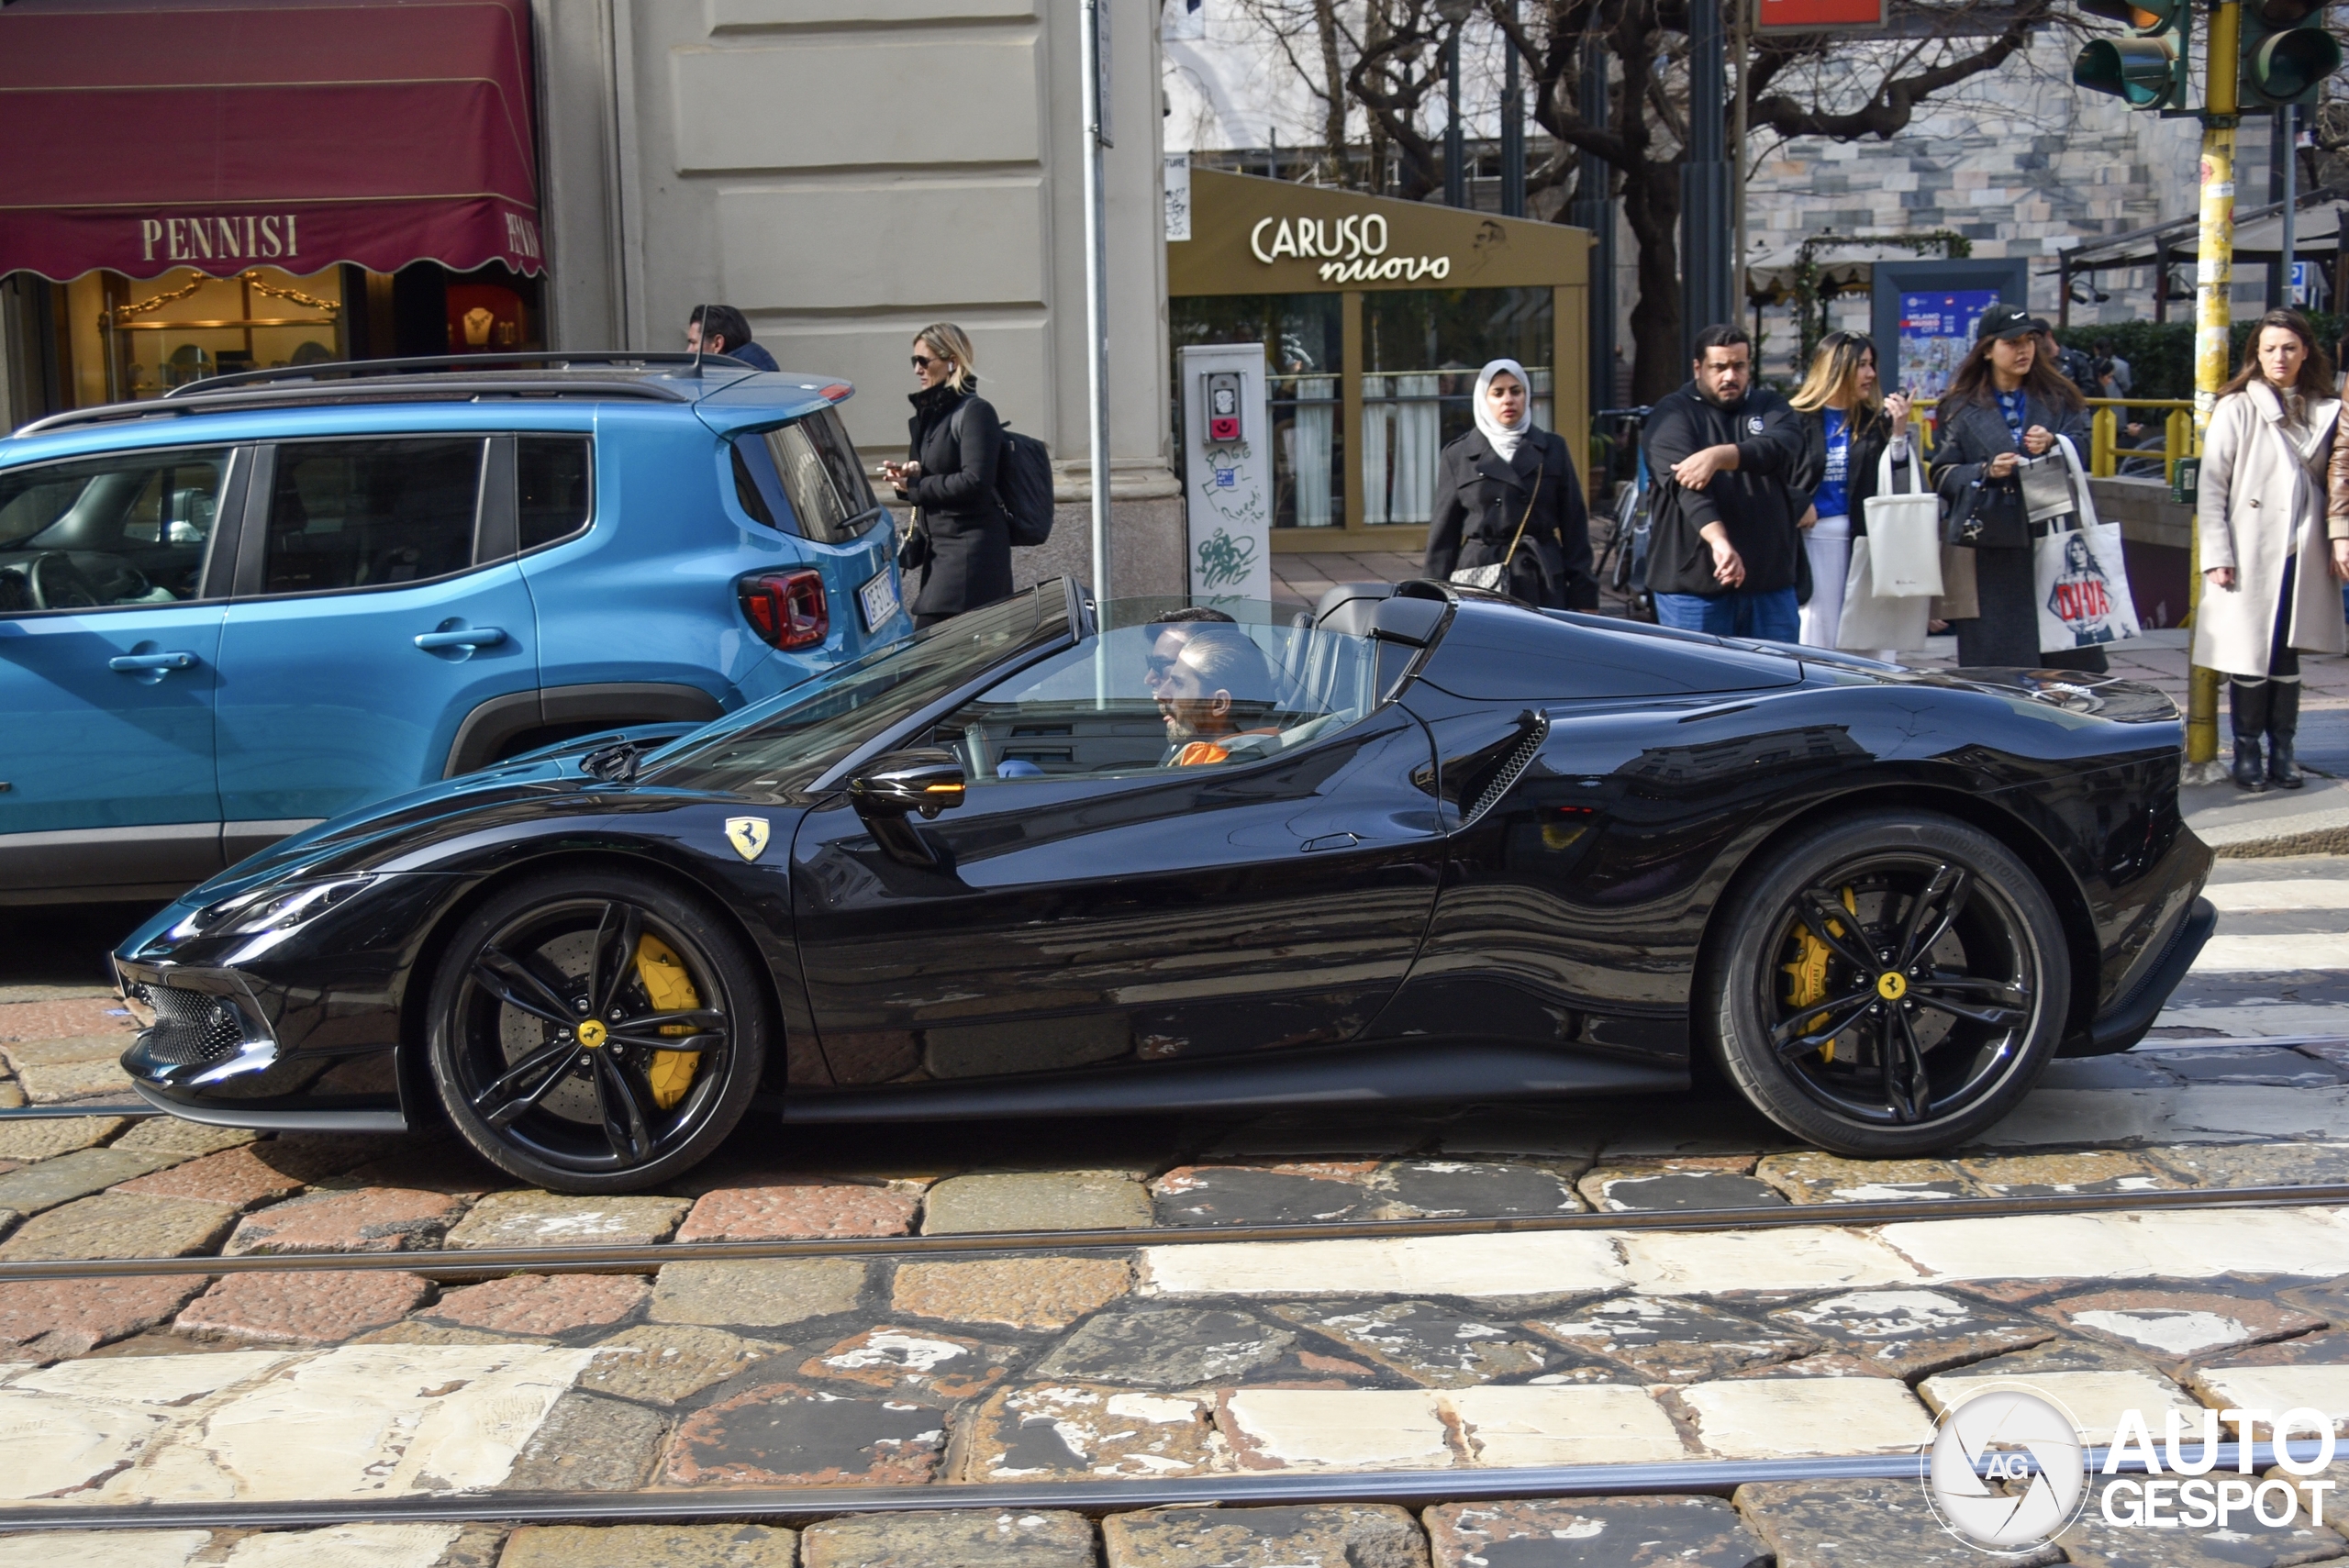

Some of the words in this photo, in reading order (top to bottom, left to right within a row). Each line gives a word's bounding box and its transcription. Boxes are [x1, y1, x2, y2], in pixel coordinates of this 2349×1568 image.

[141, 215, 298, 261] PENNISI
[1251, 213, 1388, 264] CARUSO
[1318, 255, 1450, 284] nuovo
[2057, 580, 2110, 620] DIVA
